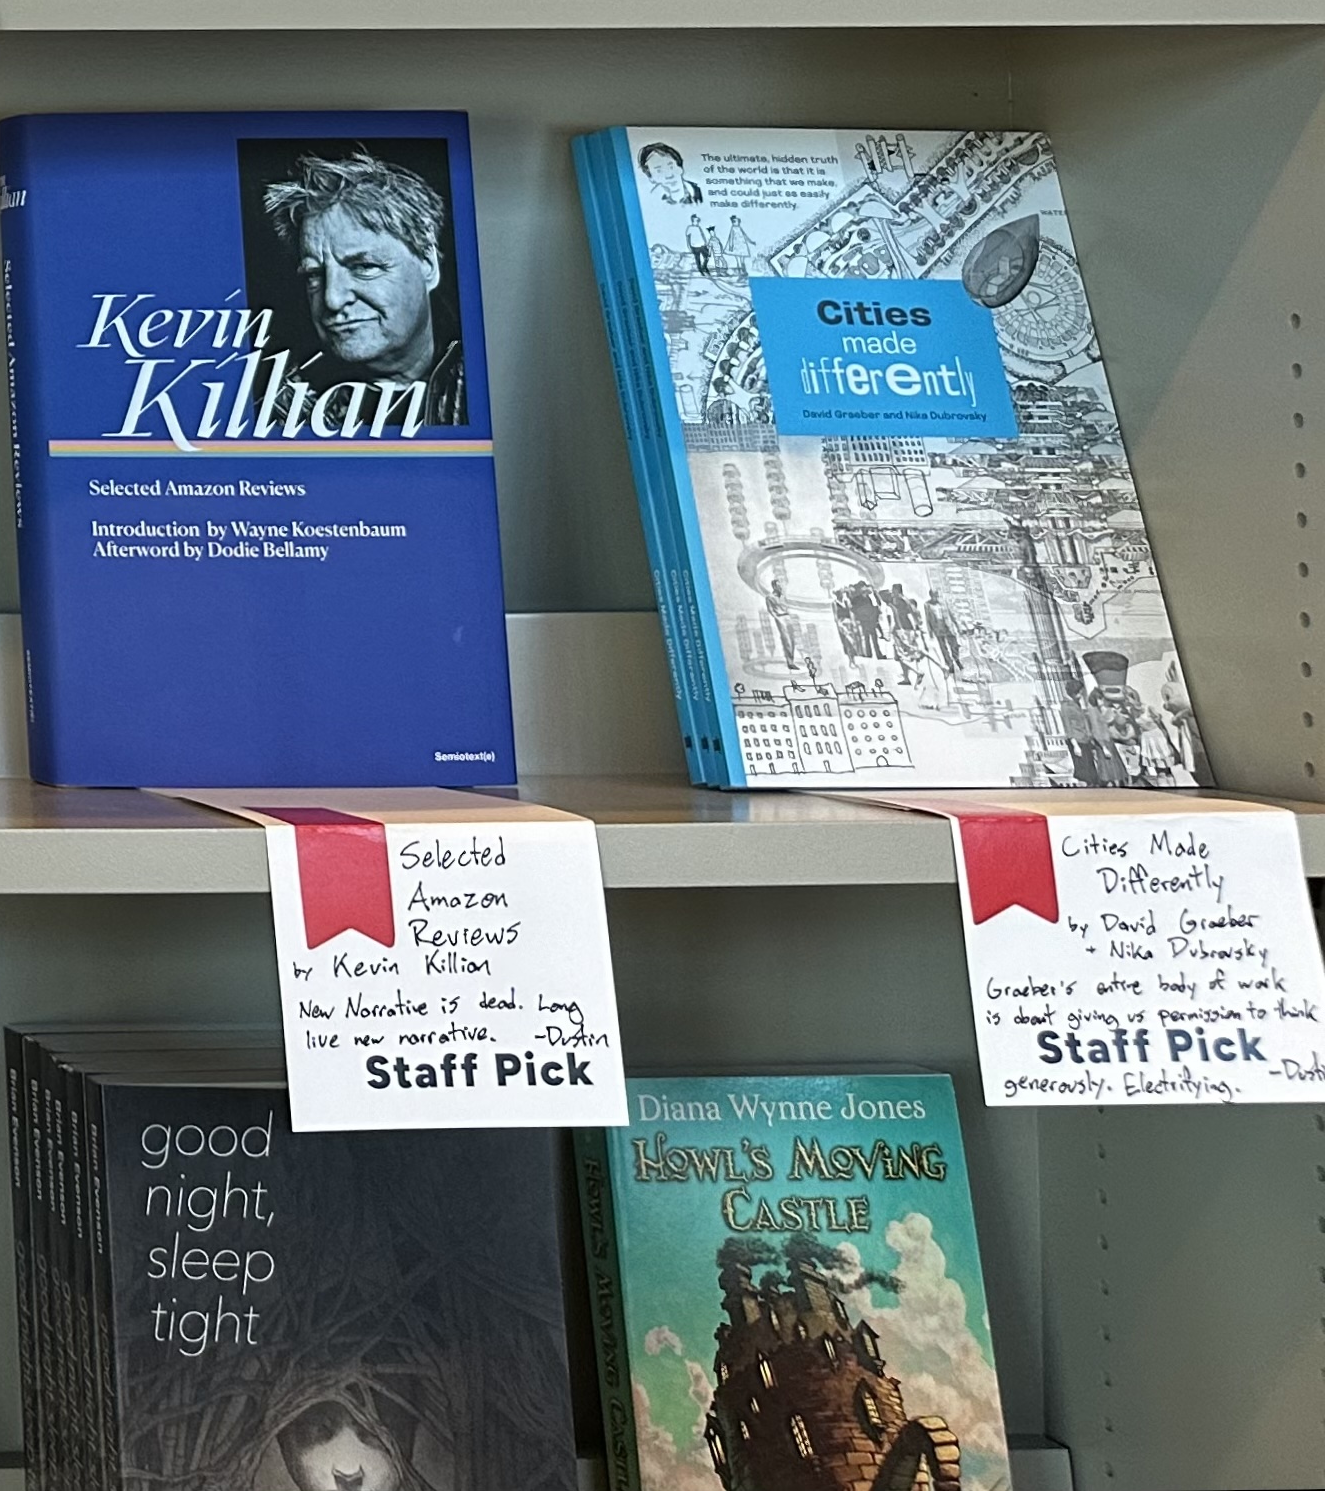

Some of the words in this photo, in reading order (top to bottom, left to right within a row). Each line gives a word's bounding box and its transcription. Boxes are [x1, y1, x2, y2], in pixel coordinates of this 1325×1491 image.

[76, 289, 274, 359] Kevin
[817, 300, 932, 327] Cities
[842, 331, 917, 355] made
[101, 348, 431, 452] Killian
[89, 479, 161, 498] Selected
[165, 479, 235, 499] Amazon
[239, 479, 306, 497] Reviews
[91, 520, 200, 539] Introduction
[206, 520, 227, 541] by
[231, 520, 287, 541] Wayne
[291, 520, 406, 539] Koestenbaum
[93, 540, 180, 561] Afterword
[184, 540, 204, 563] by
[208, 540, 258, 559] Dodie
[262, 540, 329, 563] Bellamy
[435, 749, 495, 764] Semiotext(e)
[400, 836, 506, 870] Selected
[1061, 833, 1129, 858] Cities
[1149, 830, 1210, 858] Made
[408, 881, 508, 911] Amazon
[1096, 863, 1225, 903] Differently
[408, 919, 522, 948] Reviews
[1037, 1028, 1149, 1064] Staff
[1165, 1027, 1267, 1062] Pick
[366, 1053, 478, 1090] Staff
[495, 1051, 594, 1087] Pick
[638, 1094, 722, 1124] Diana
[728, 1094, 833, 1126] Wynne
[841, 1092, 926, 1121] Jones
[141, 1110, 274, 1169] good
[145, 1171, 275, 1232] night,
[721, 1185, 872, 1233] CASTLE
[148, 1231, 275, 1295] sleep
[151, 1295, 261, 1358] tight
